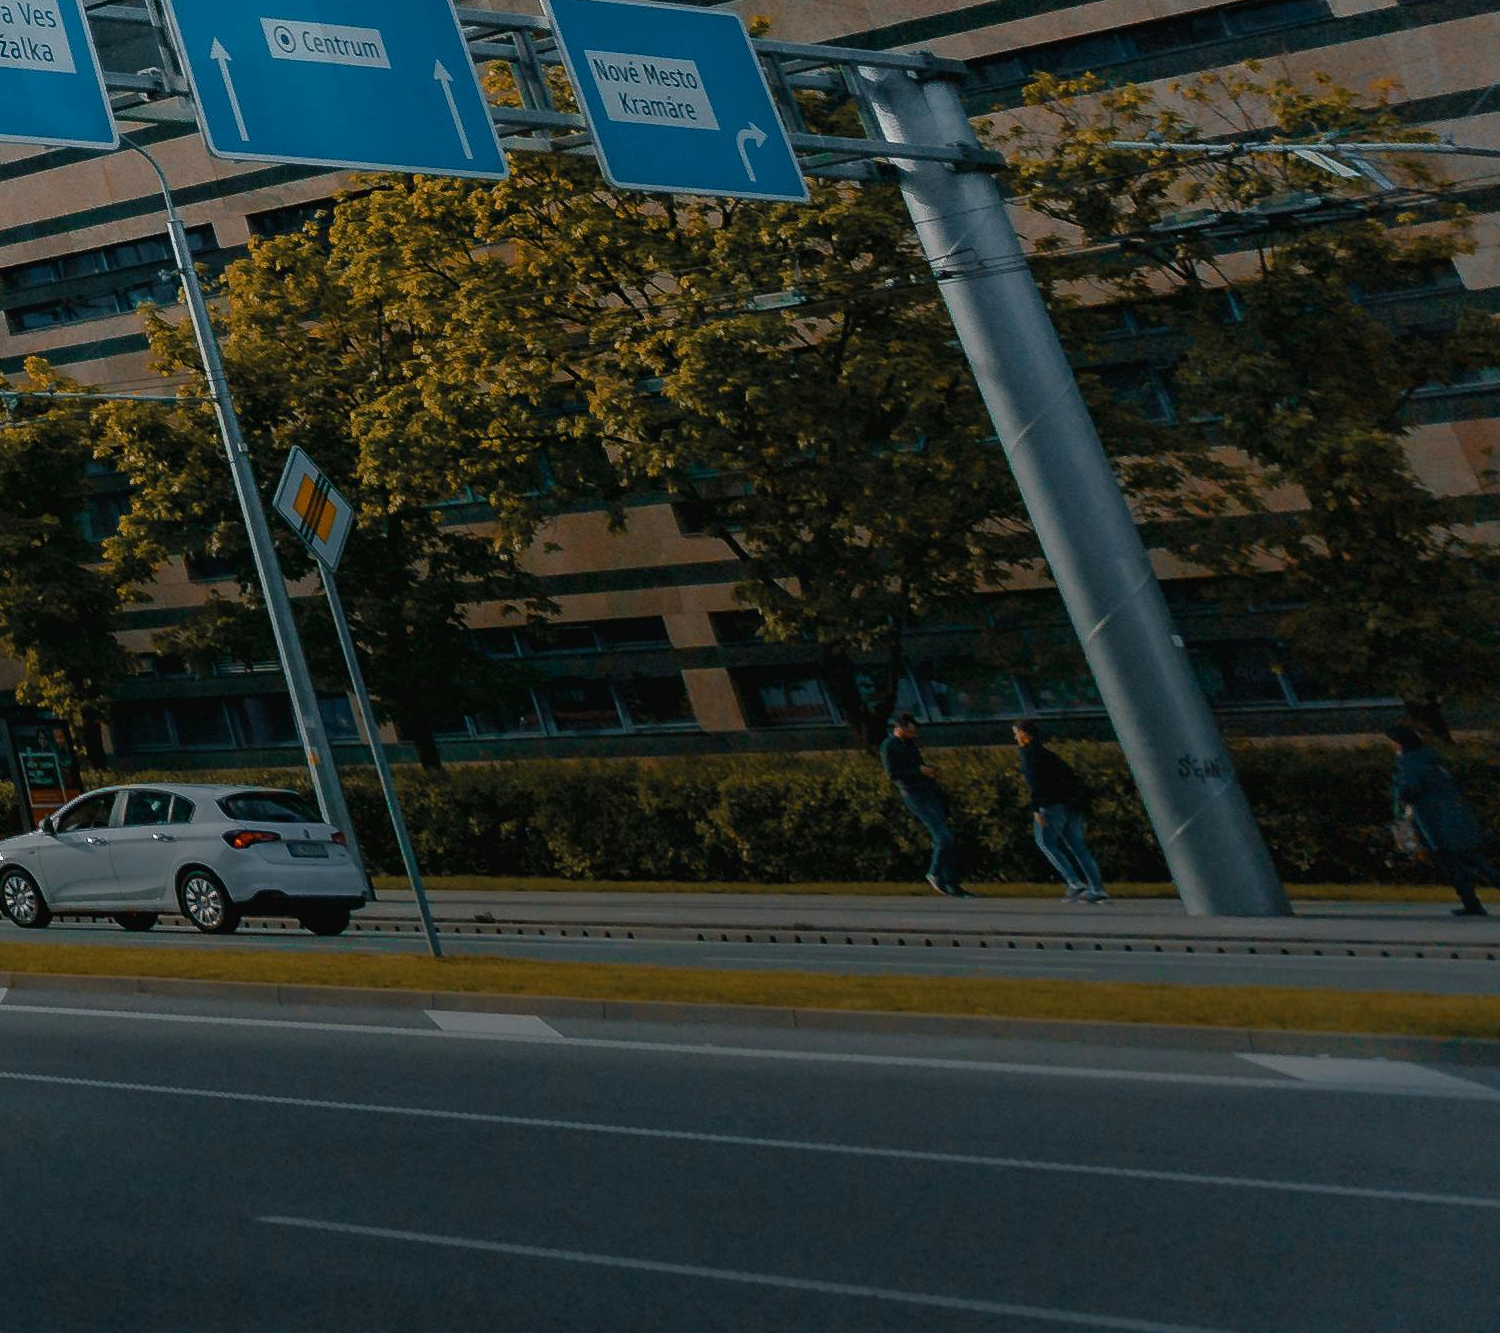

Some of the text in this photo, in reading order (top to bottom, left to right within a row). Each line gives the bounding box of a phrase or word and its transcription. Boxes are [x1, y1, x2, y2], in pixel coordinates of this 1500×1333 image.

[17, 1, 57, 29] Ves
[302, 30, 380, 59] Centrum
[592, 58, 698, 90] Nové Mesto
[618, 92, 698, 120] Kramáre
